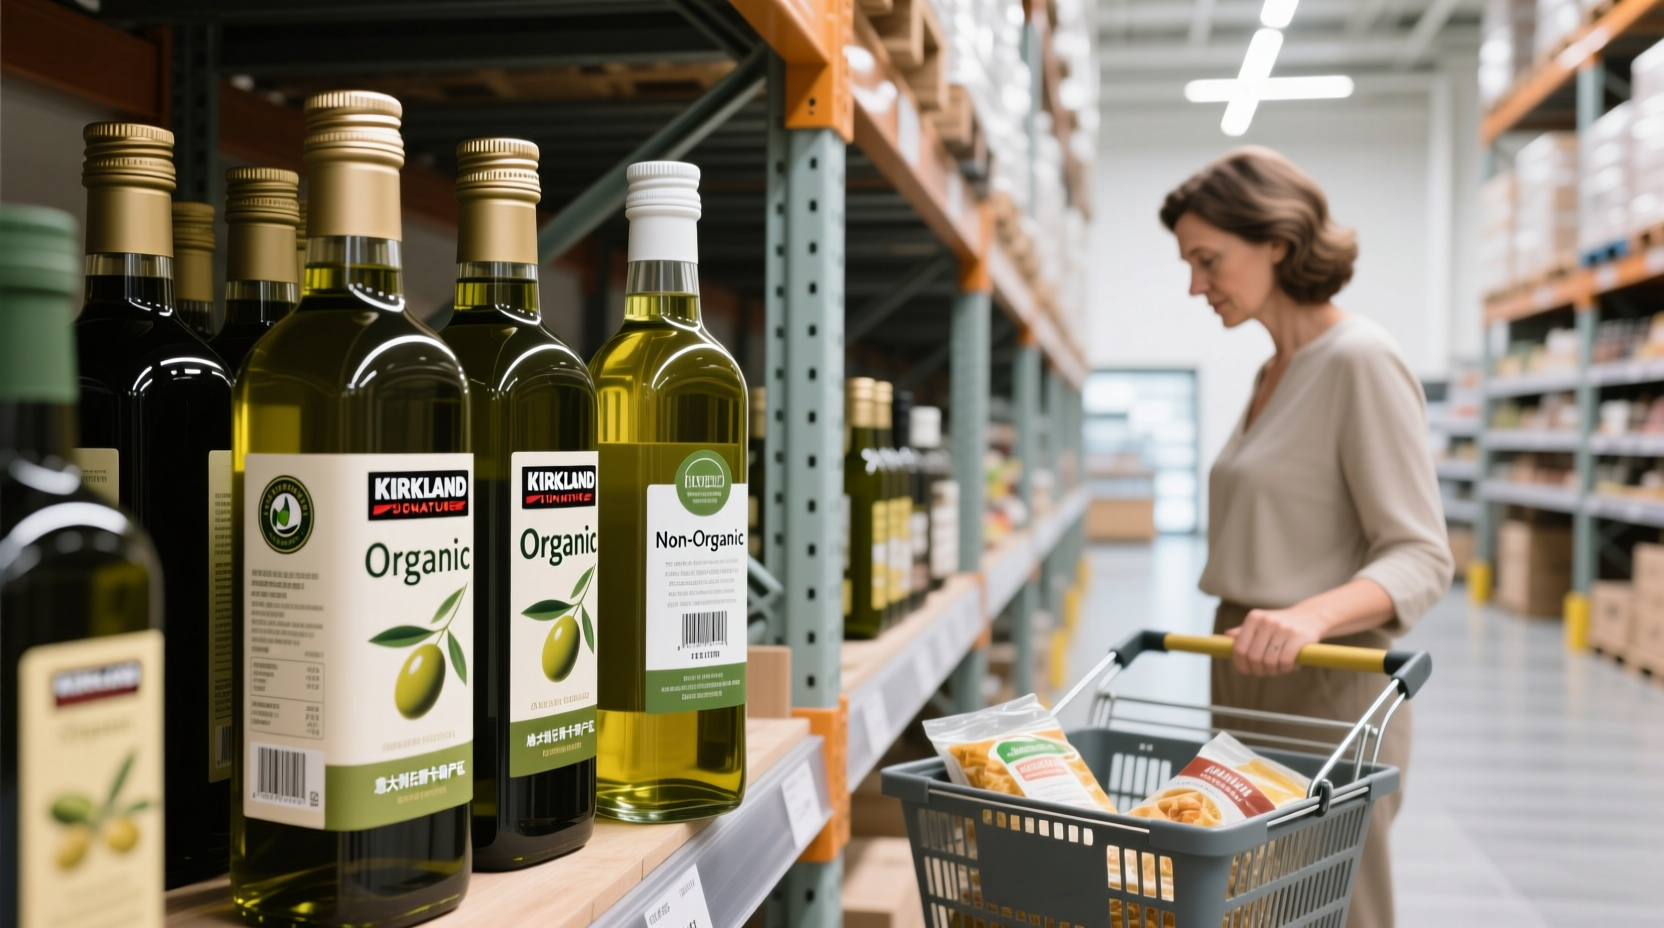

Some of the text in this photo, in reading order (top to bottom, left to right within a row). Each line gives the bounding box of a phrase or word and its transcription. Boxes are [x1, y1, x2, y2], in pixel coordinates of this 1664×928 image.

[374, 476, 467, 501] KIRKLAND
[527, 470, 595, 491] KIRKLAND
[520, 525, 597, 566] Organic
[656, 528, 744, 552] Non-Organic
[365, 537, 470, 586] Organic
